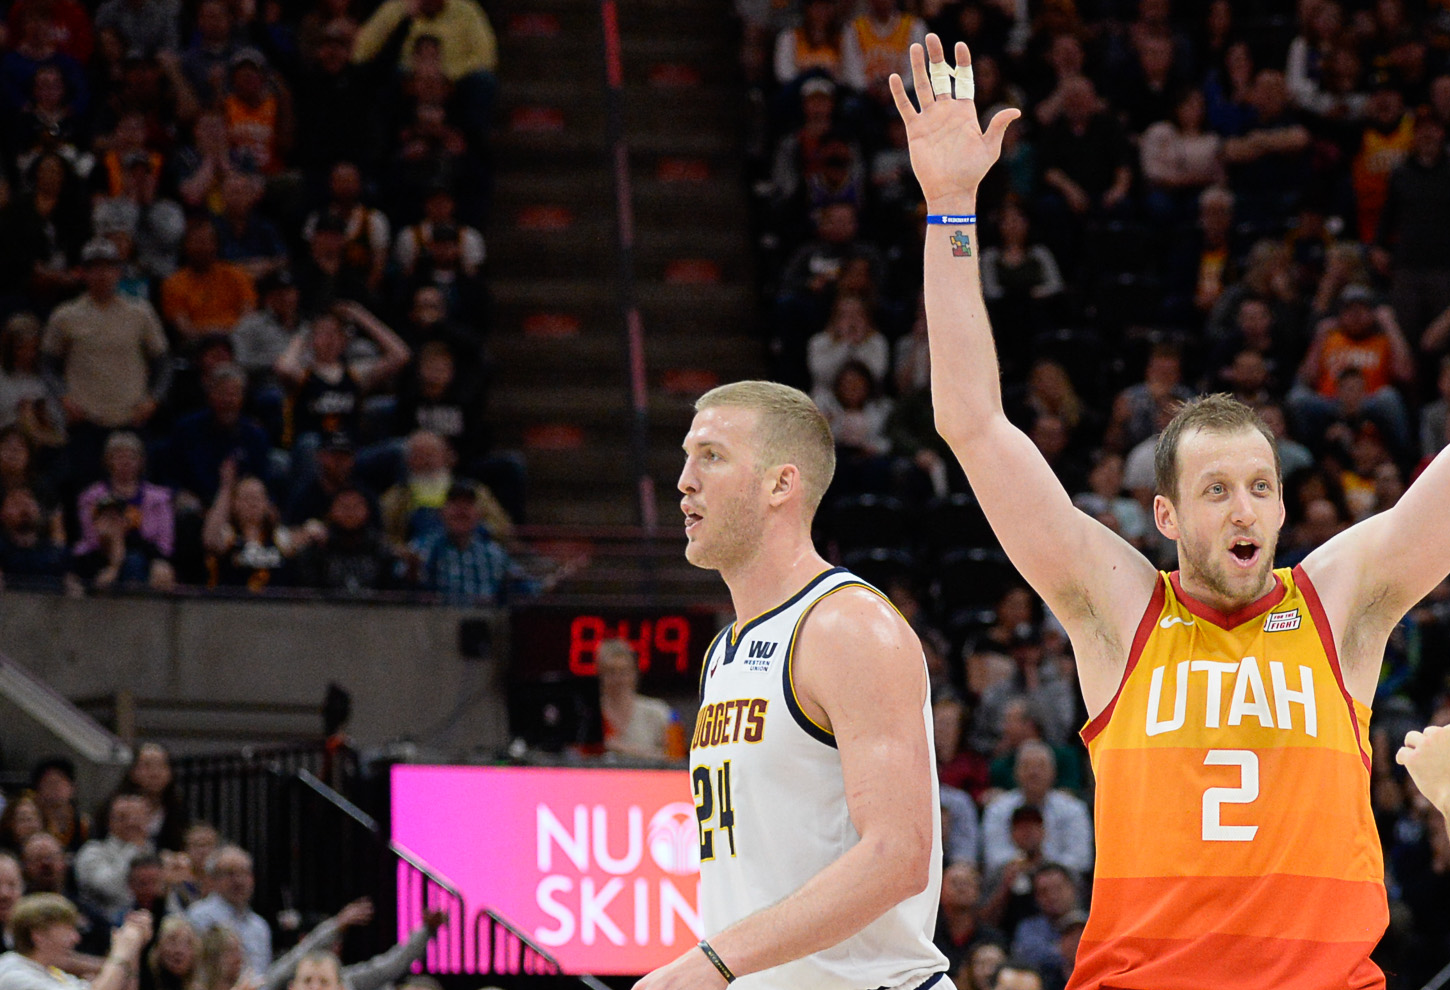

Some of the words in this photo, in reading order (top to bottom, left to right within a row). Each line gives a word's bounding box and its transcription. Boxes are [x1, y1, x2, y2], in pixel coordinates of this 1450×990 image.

[749, 640, 778, 659] WU
[1271, 620, 1297, 629] FIGHT
[690, 698, 768, 751] UGGETS
[1146, 656, 1317, 737] UTAH
[693, 758, 736, 862] 24
[1202, 749, 1260, 841] 2
[536, 803, 643, 875] NU
[534, 874, 705, 946] SKIN
